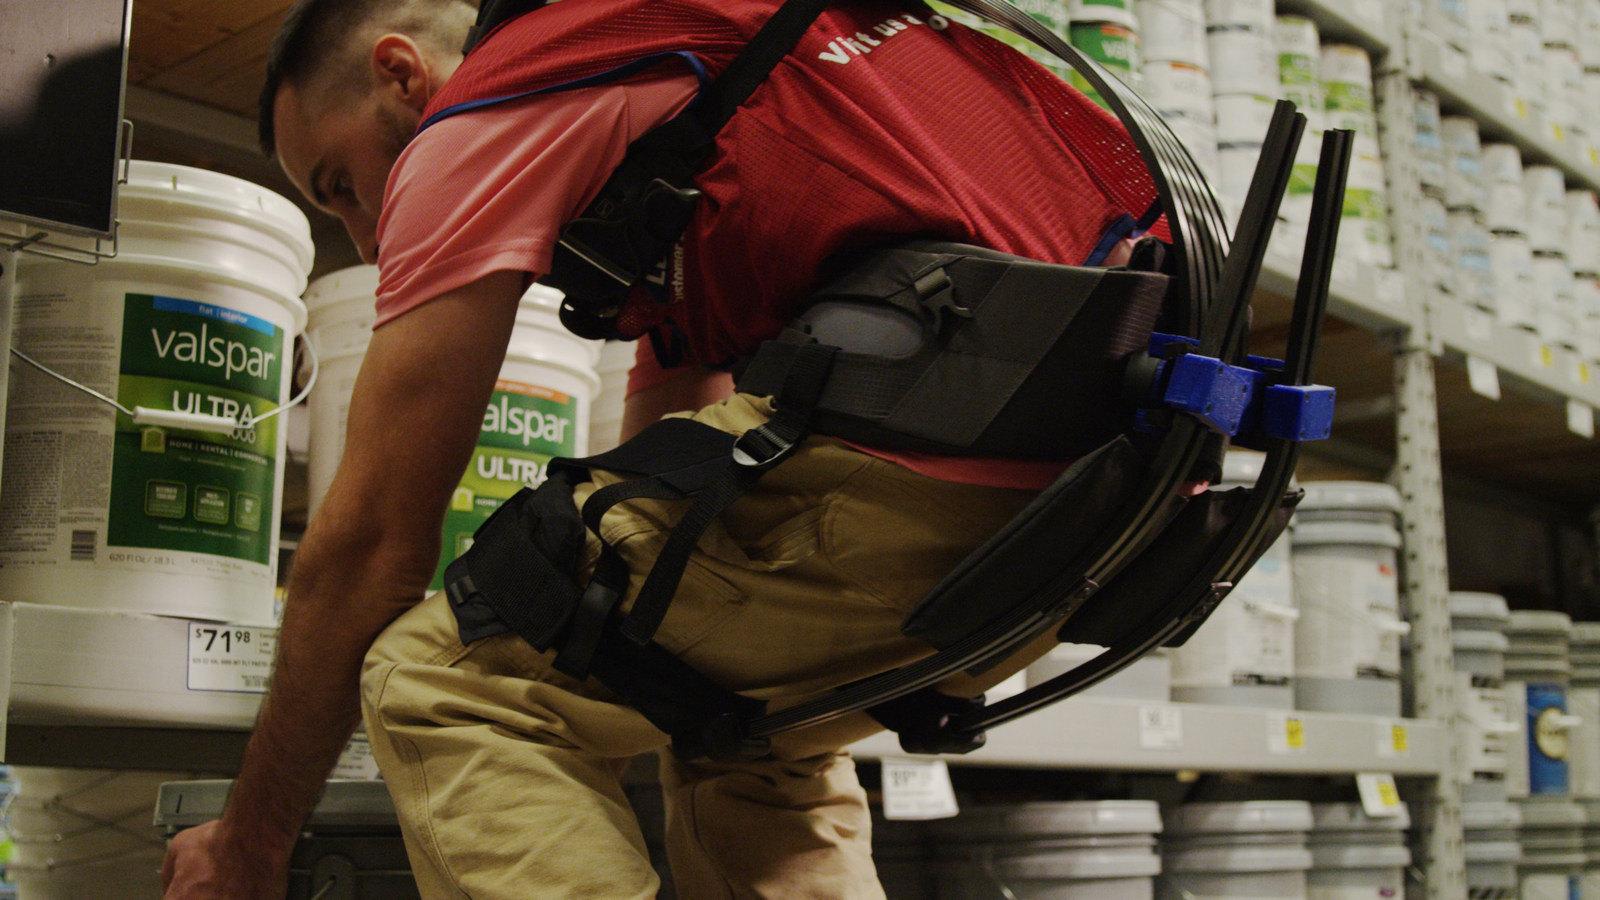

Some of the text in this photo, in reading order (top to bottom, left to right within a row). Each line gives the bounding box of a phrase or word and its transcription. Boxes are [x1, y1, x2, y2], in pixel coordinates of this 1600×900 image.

[873, 19, 908, 37] us
[672, 243, 685, 302] ustomer
[151, 323, 276, 380] valspar
[172, 390, 255, 428] ULTRA
[481, 395, 569, 446] alspar
